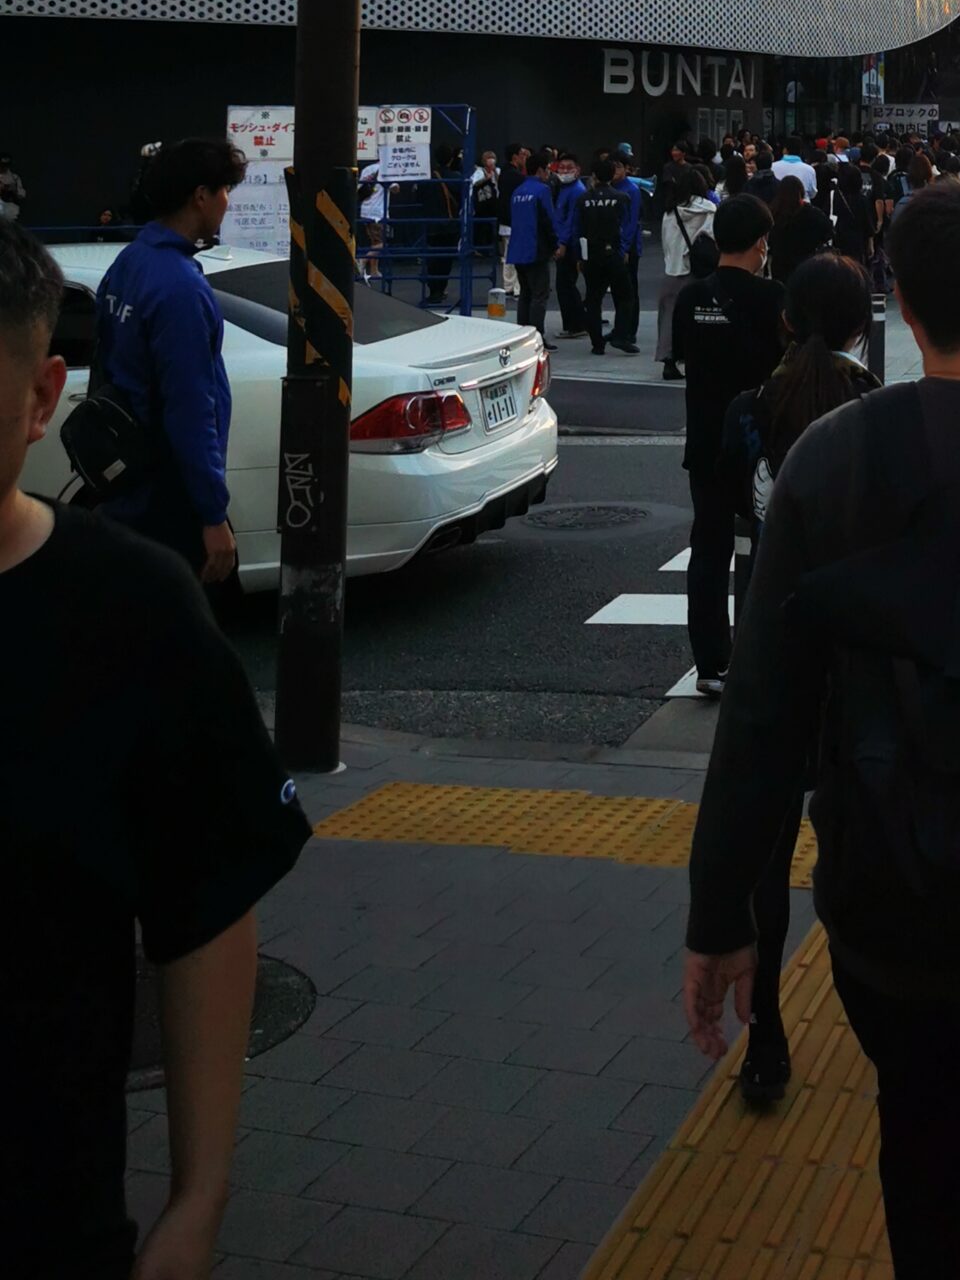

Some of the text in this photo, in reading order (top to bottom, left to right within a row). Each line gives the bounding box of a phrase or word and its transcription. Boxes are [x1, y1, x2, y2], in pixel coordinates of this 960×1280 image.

[602, 48, 755, 100] BUNTAI
[946, 122, 954, 136] A
[584, 199, 618, 208] STAFF
